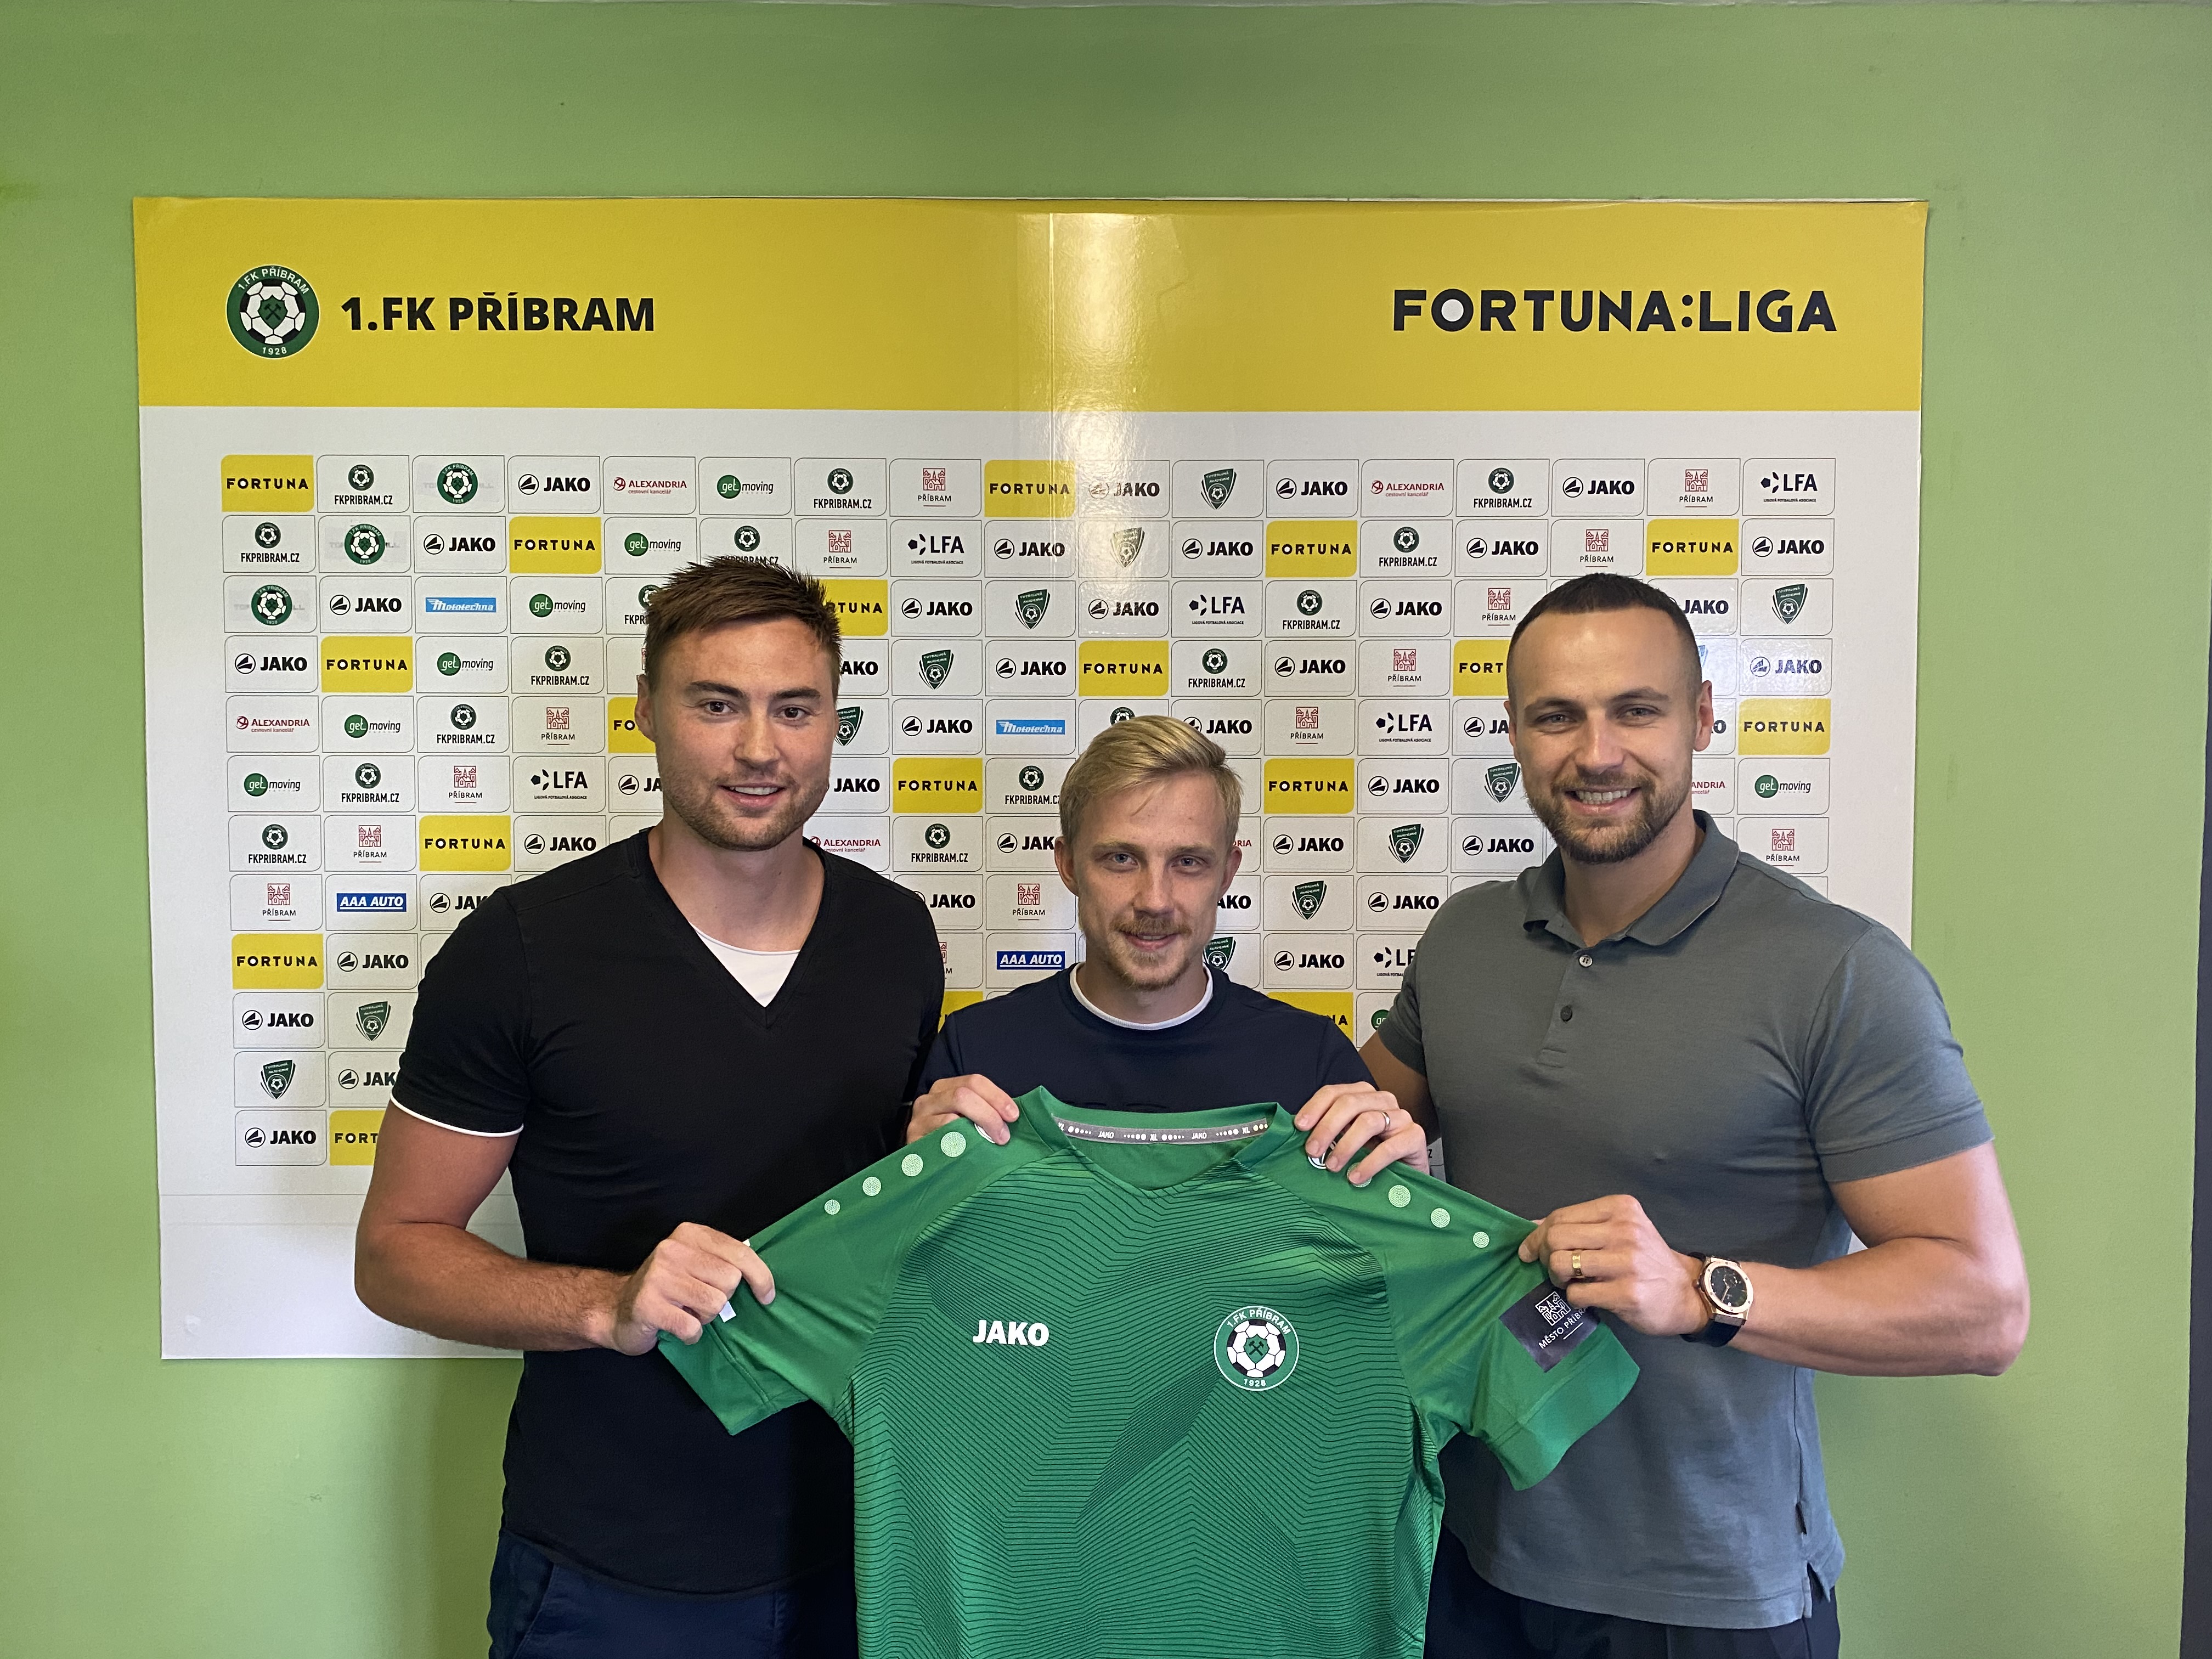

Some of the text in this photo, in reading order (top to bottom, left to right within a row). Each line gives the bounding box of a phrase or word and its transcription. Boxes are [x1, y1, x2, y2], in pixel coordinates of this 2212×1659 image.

[238, 266, 309, 294] 1.FK PŘÍBRAM
[341, 292, 653, 331] 1.FK PŘÍBRAM
[262, 347, 287, 355] 1928
[227, 478, 308, 489] FORTUNA
[544, 477, 590, 492] JAKO
[721, 478, 773, 495] get moving
[990, 483, 1069, 494] FORTUNA
[1301, 482, 1347, 495] JAKO
[1588, 481, 1634, 494] JAKO
[1784, 474, 1818, 491] LFA
[1114, 483, 1160, 496] JAKO
[335, 495, 392, 505] FKPRIBRAM.CZ
[814, 499, 871, 509] FKPRIBRAM.CZ
[1474, 498, 1532, 507] FKPRIBRAM.CZ
[449, 538, 495, 551] JAKO
[515, 540, 595, 550] FORTUNA
[629, 535, 681, 552] get moving
[931, 536, 964, 553] LFA
[1019, 542, 1065, 556] JAKO
[1207, 542, 1253, 556] JAKO
[1272, 544, 1351, 555] FORTUNA
[1492, 541, 1538, 555] JAKO
[1652, 542, 1733, 552] FORTUNA
[1778, 540, 1824, 554] JAKO
[241, 553, 300, 562] FKPRIBRAM.CZ
[1379, 557, 1437, 566] FKPRIBRAM.CZ
[356, 598, 402, 612] JAKO
[533, 596, 585, 613] get moving
[826, 602, 883, 613] RTUNA
[927, 602, 972, 616] JAKO
[1113, 602, 1159, 616] JAKO
[1212, 597, 1245, 613] LFA
[1396, 602, 1442, 616] JAKO
[1683, 600, 1729, 614] JAKO
[1283, 620, 1340, 629] FKPRIBRAM.CZ
[261, 657, 307, 671] JAKO
[327, 659, 407, 670] FORTUNA
[442, 656, 493, 672] get moving
[841, 662, 878, 675] AKO
[1021, 662, 1066, 675] JAKO
[1084, 663, 1163, 674] FORTUNA
[1300, 660, 1345, 673] JAKO
[1459, 663, 1503, 673] FORT
[1775, 660, 1822, 674] JAKO
[531, 676, 589, 685] FKPRIBRAM.CZ
[1189, 679, 1245, 687] FKPRIBRAM.CZ
[349, 717, 400, 733] get moving
[927, 720, 972, 733] JAKO
[1206, 720, 1252, 733] JAKO
[1399, 714, 1432, 731] LFA
[1489, 720, 1509, 733] JA
[1744, 721, 1824, 732] FORTUNA
[437, 735, 495, 743] FKPRIBRAM.CZ
[249, 775, 300, 792] get moving
[554, 771, 588, 788] LFA
[644, 778, 662, 792] JA
[834, 778, 880, 792] JAKO
[899, 780, 977, 791] FORTUNA
[1269, 781, 1348, 791] FORTUNA
[1758, 777, 1811, 793] get moving
[1393, 780, 1439, 793] JAKO
[342, 793, 399, 802] FKPRIBRAM.CZ
[425, 838, 505, 849] FORTUNA
[550, 837, 596, 851] JAKO
[1022, 836, 1055, 850] JAK
[1298, 838, 1344, 851] JAKO
[1487, 839, 1534, 853] JAKO
[249, 854, 306, 863] FKPRIBRAM.CZ
[912, 853, 968, 862] FKPRIBRAM.CZ
[340, 896, 403, 907] AAA AUTO
[455, 896, 488, 910] JA
[930, 894, 975, 908] JAKO
[1217, 895, 1251, 909] AKO
[1393, 895, 1439, 910] JAKO
[237, 956, 317, 966] FORTUNA
[363, 955, 408, 968] JAKO
[1000, 954, 1063, 964] AAA AUTO
[1299, 954, 1344, 968] JAKO
[1396, 949, 1415, 966] LF
[268, 1013, 313, 1027] JAKO
[363, 1072, 397, 1086] JAK
[270, 1131, 316, 1144] JAKO
[335, 1133, 378, 1143] FORT
[1192, 1132, 1207, 1140] JAKO
[1227, 1308, 1291, 1335] 1.FK PŘÍBRAM
[1538, 1307, 1588, 1349] MĚSTO PŘÍBR
[973, 1320, 1049, 1347] JAKO
[1244, 1379, 1266, 1387] 1928
